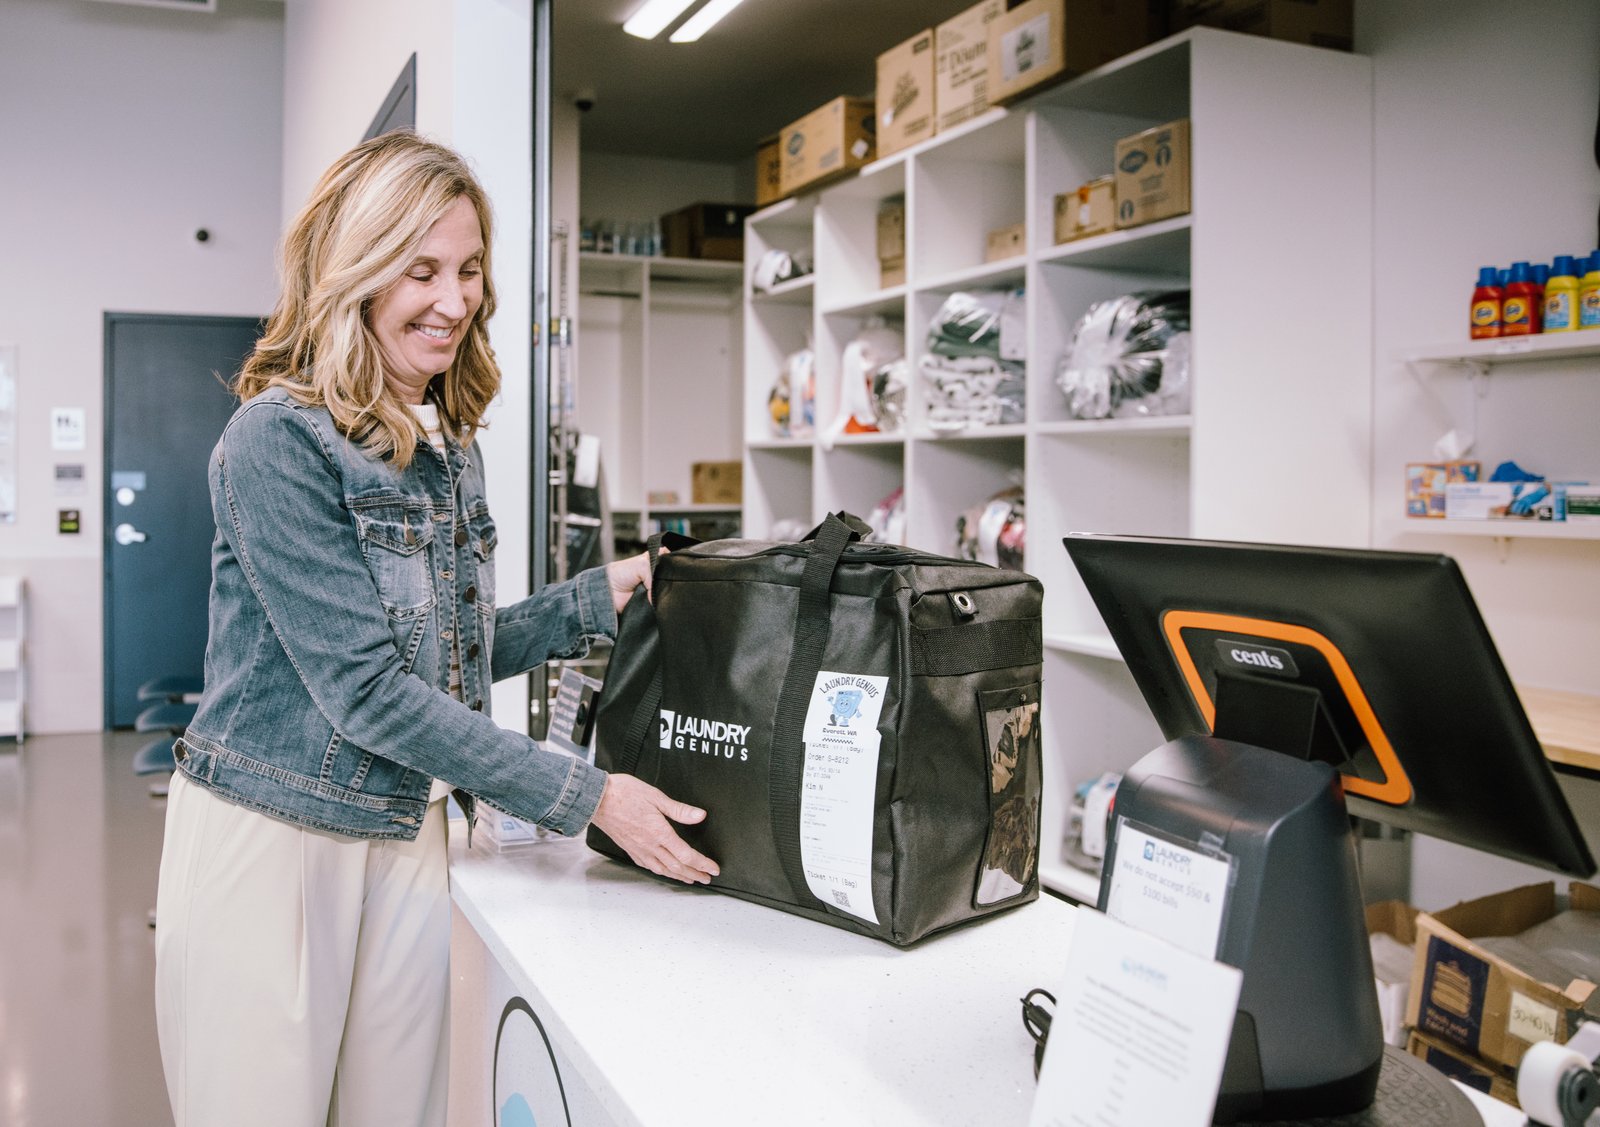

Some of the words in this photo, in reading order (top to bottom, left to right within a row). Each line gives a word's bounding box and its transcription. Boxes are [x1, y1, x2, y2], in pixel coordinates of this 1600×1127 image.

[1230, 648, 1284, 670] cents
[819, 676, 856, 694] LAUNDRY
[855, 678, 880, 698] GENIUS
[675, 714, 751, 746] LAUNDRY
[674, 735, 749, 761] GENIUS
[807, 752, 825, 761] Order
[805, 782, 817, 790] Kim
[1155, 846, 1193, 865] LAUNDRY
[807, 870, 827, 881] Ticket
[1122, 860, 1134, 871] We
[1134, 866, 1145, 876] do
[1145, 871, 1158, 882] not
[1159, 877, 1185, 893] accept
[1142, 885, 1161, 902] $100
[1161, 894, 1179, 910] bills
